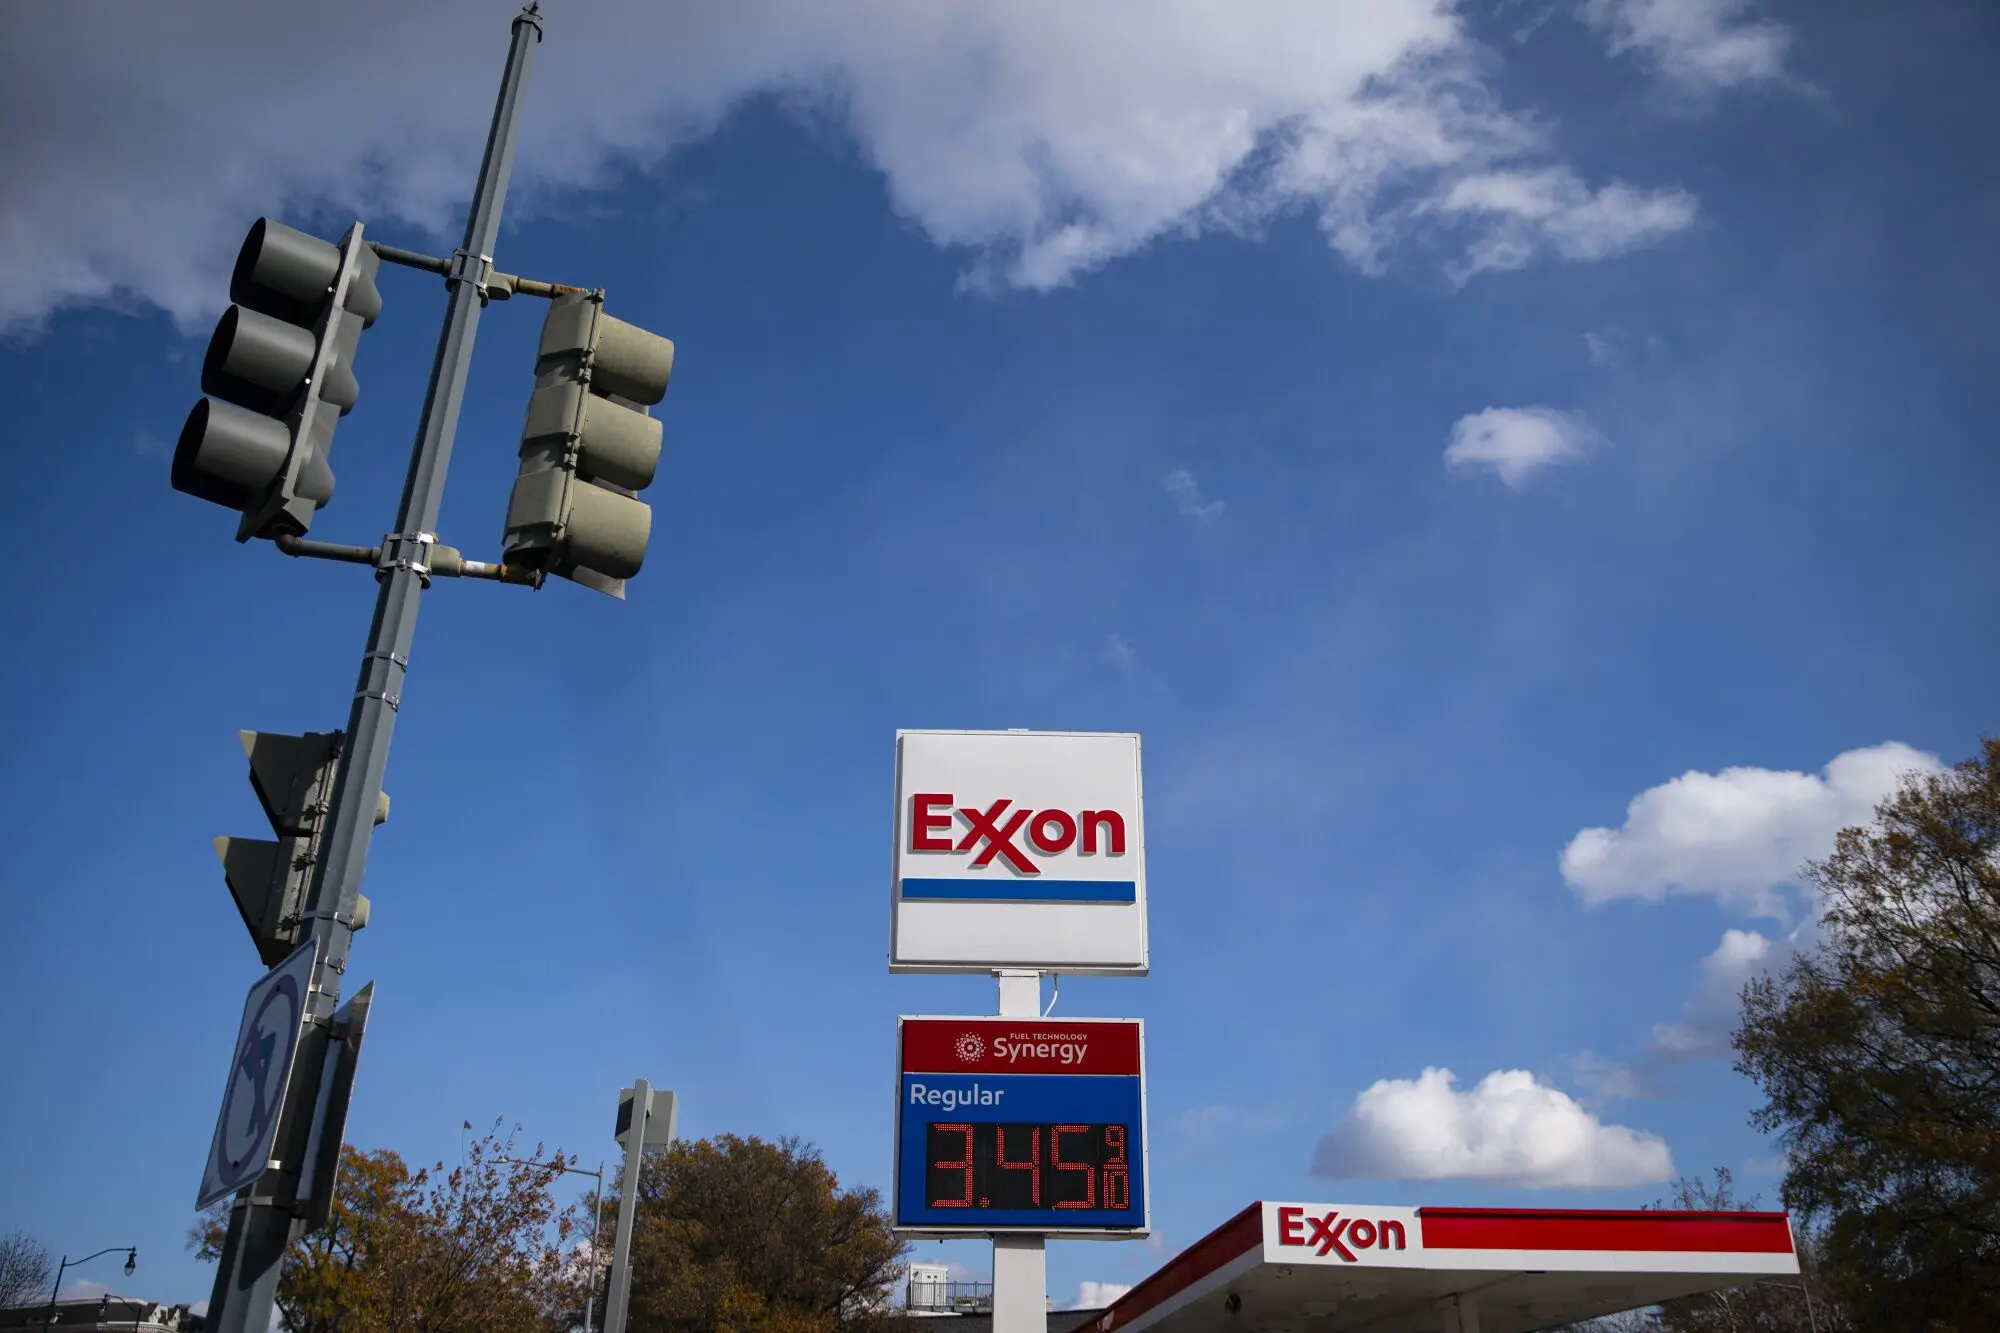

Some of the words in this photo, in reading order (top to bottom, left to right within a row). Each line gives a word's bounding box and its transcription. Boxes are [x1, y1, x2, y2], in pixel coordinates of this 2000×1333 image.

[912, 793, 1126, 876] Exxon
[993, 1038, 1088, 1064] Synergy
[1032, 1033, 1088, 1041] TECHNOLOGY
[910, 1083, 1005, 1111] Regular
[931, 1123, 1095, 1209] 3.45
[1278, 1206, 1406, 1263] Exxon
